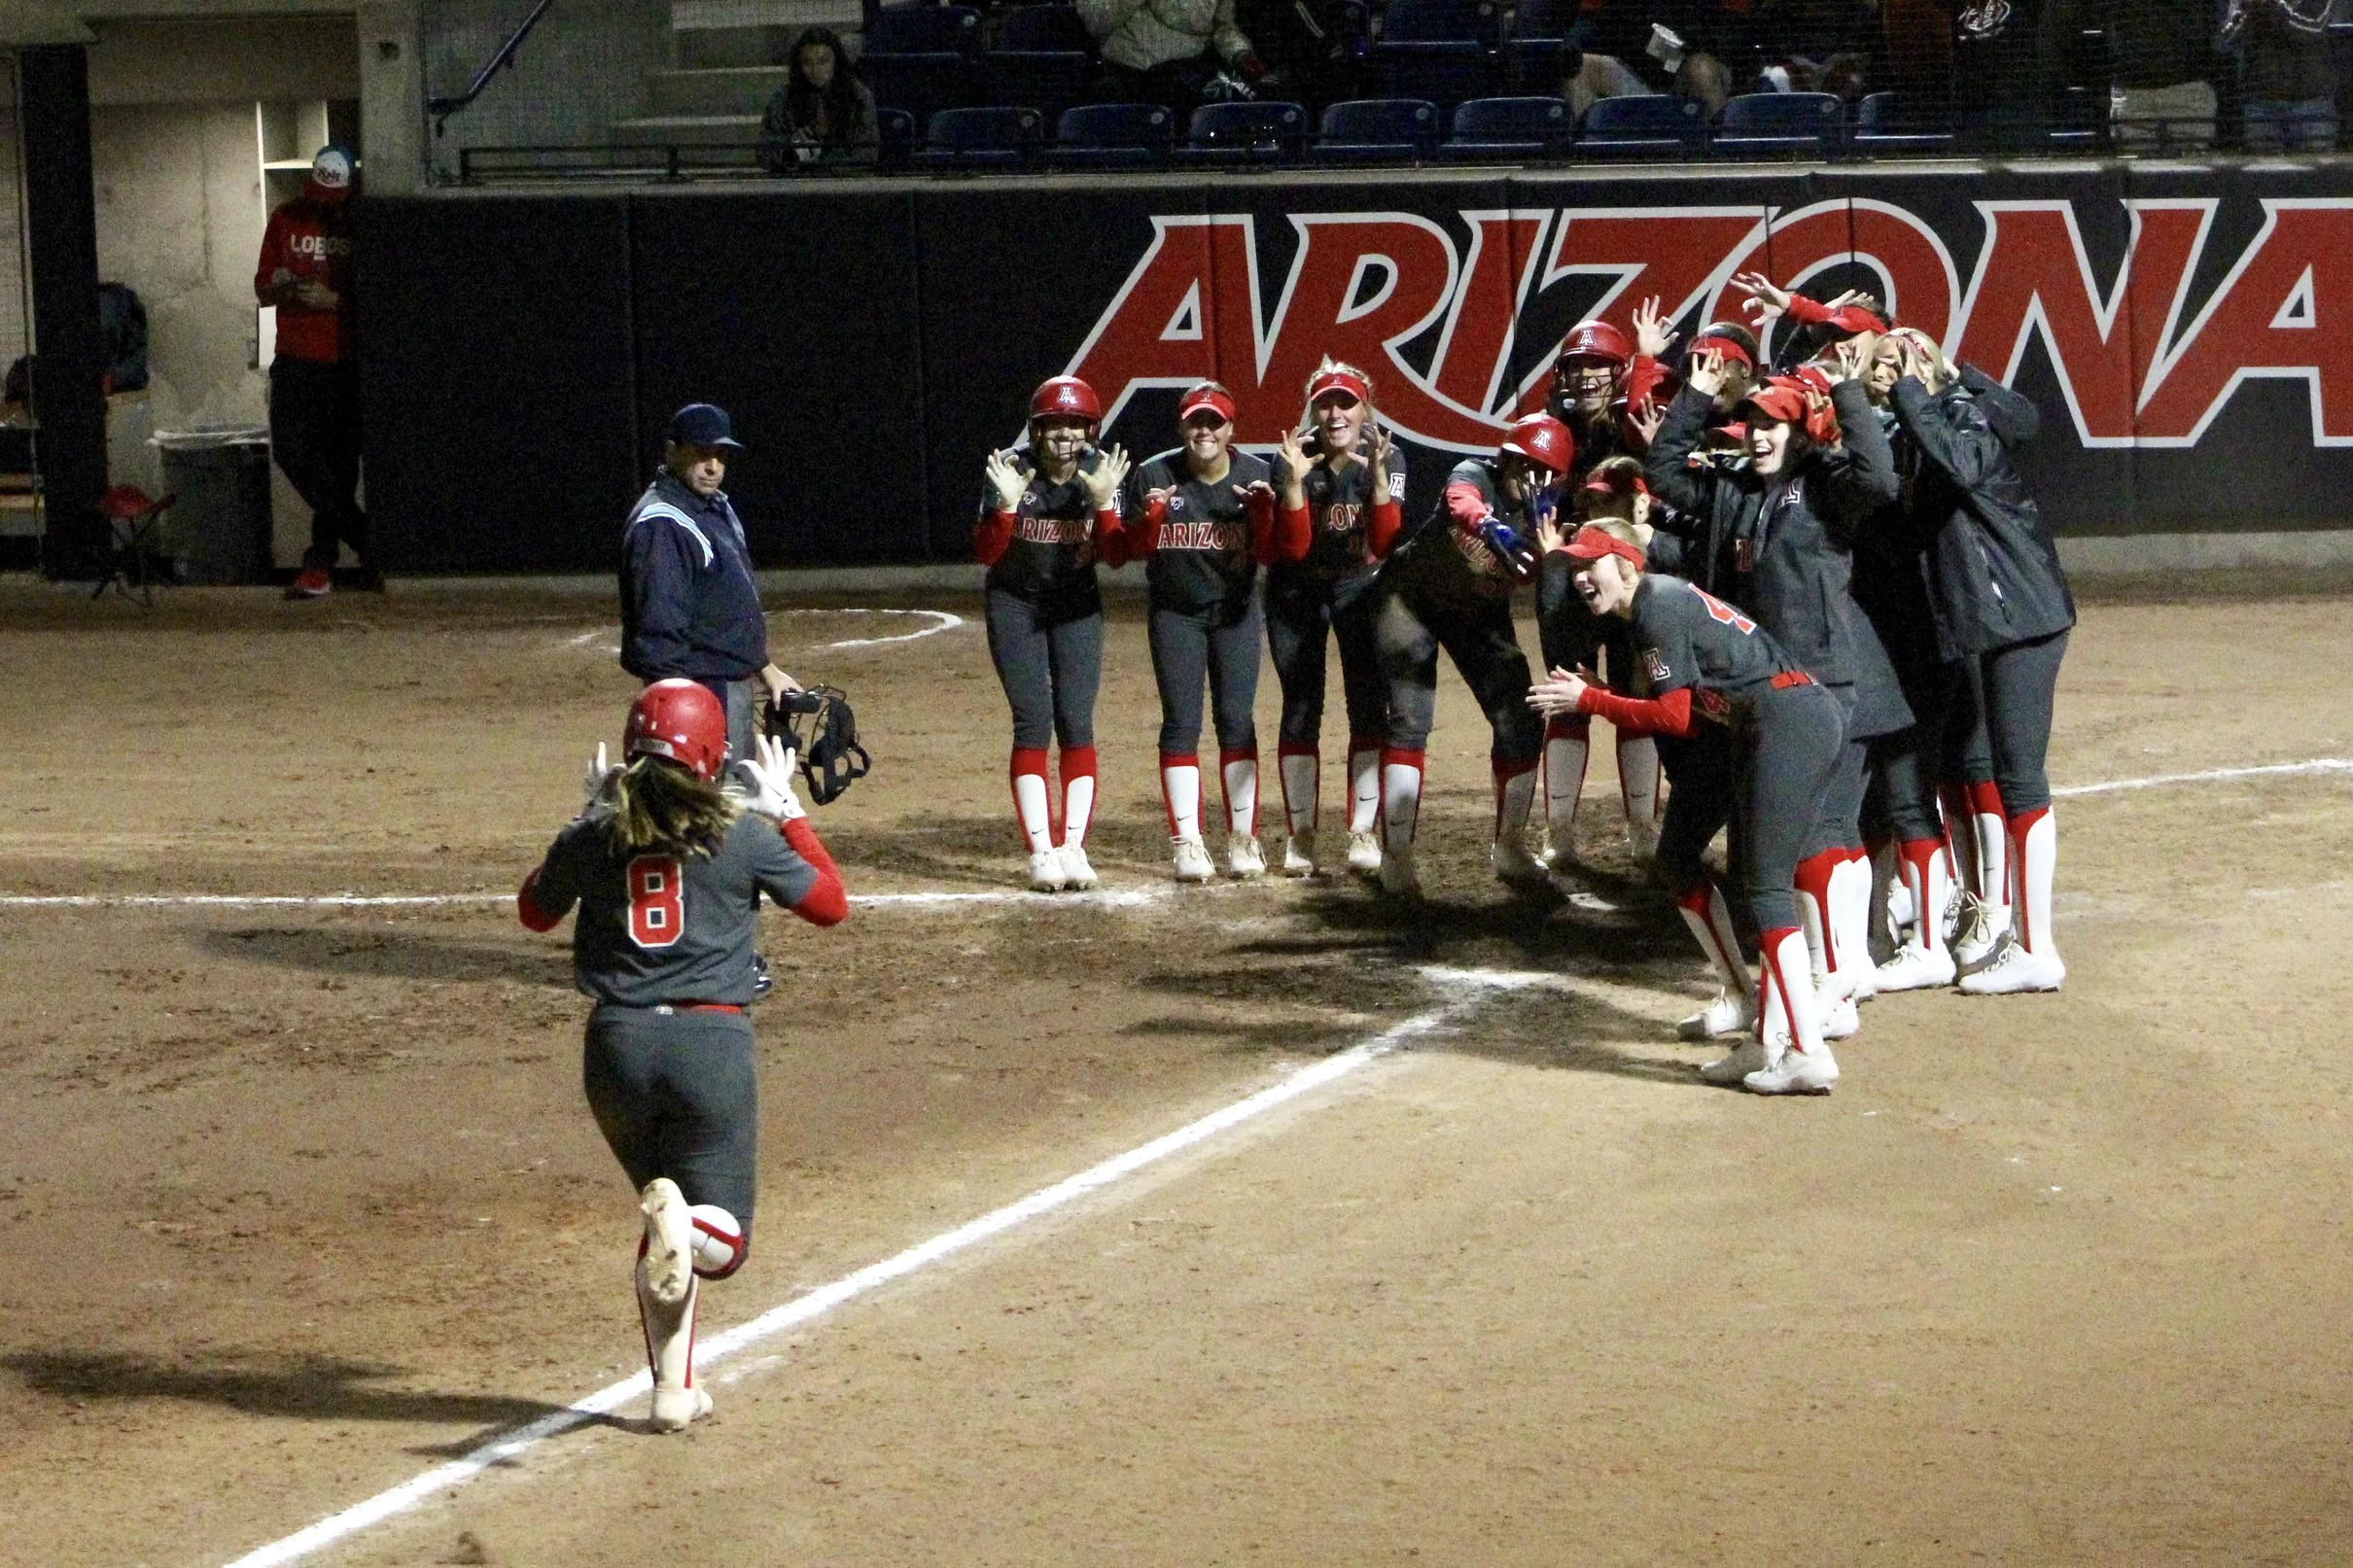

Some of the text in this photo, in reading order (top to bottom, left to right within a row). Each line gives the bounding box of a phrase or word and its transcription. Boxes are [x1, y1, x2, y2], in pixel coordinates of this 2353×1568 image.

[1013, 197, 2353, 455] ARIZONA
[1020, 517, 1094, 543] RIZON
[1156, 521, 1247, 550] ARIZON
[626, 853, 685, 949] 8
